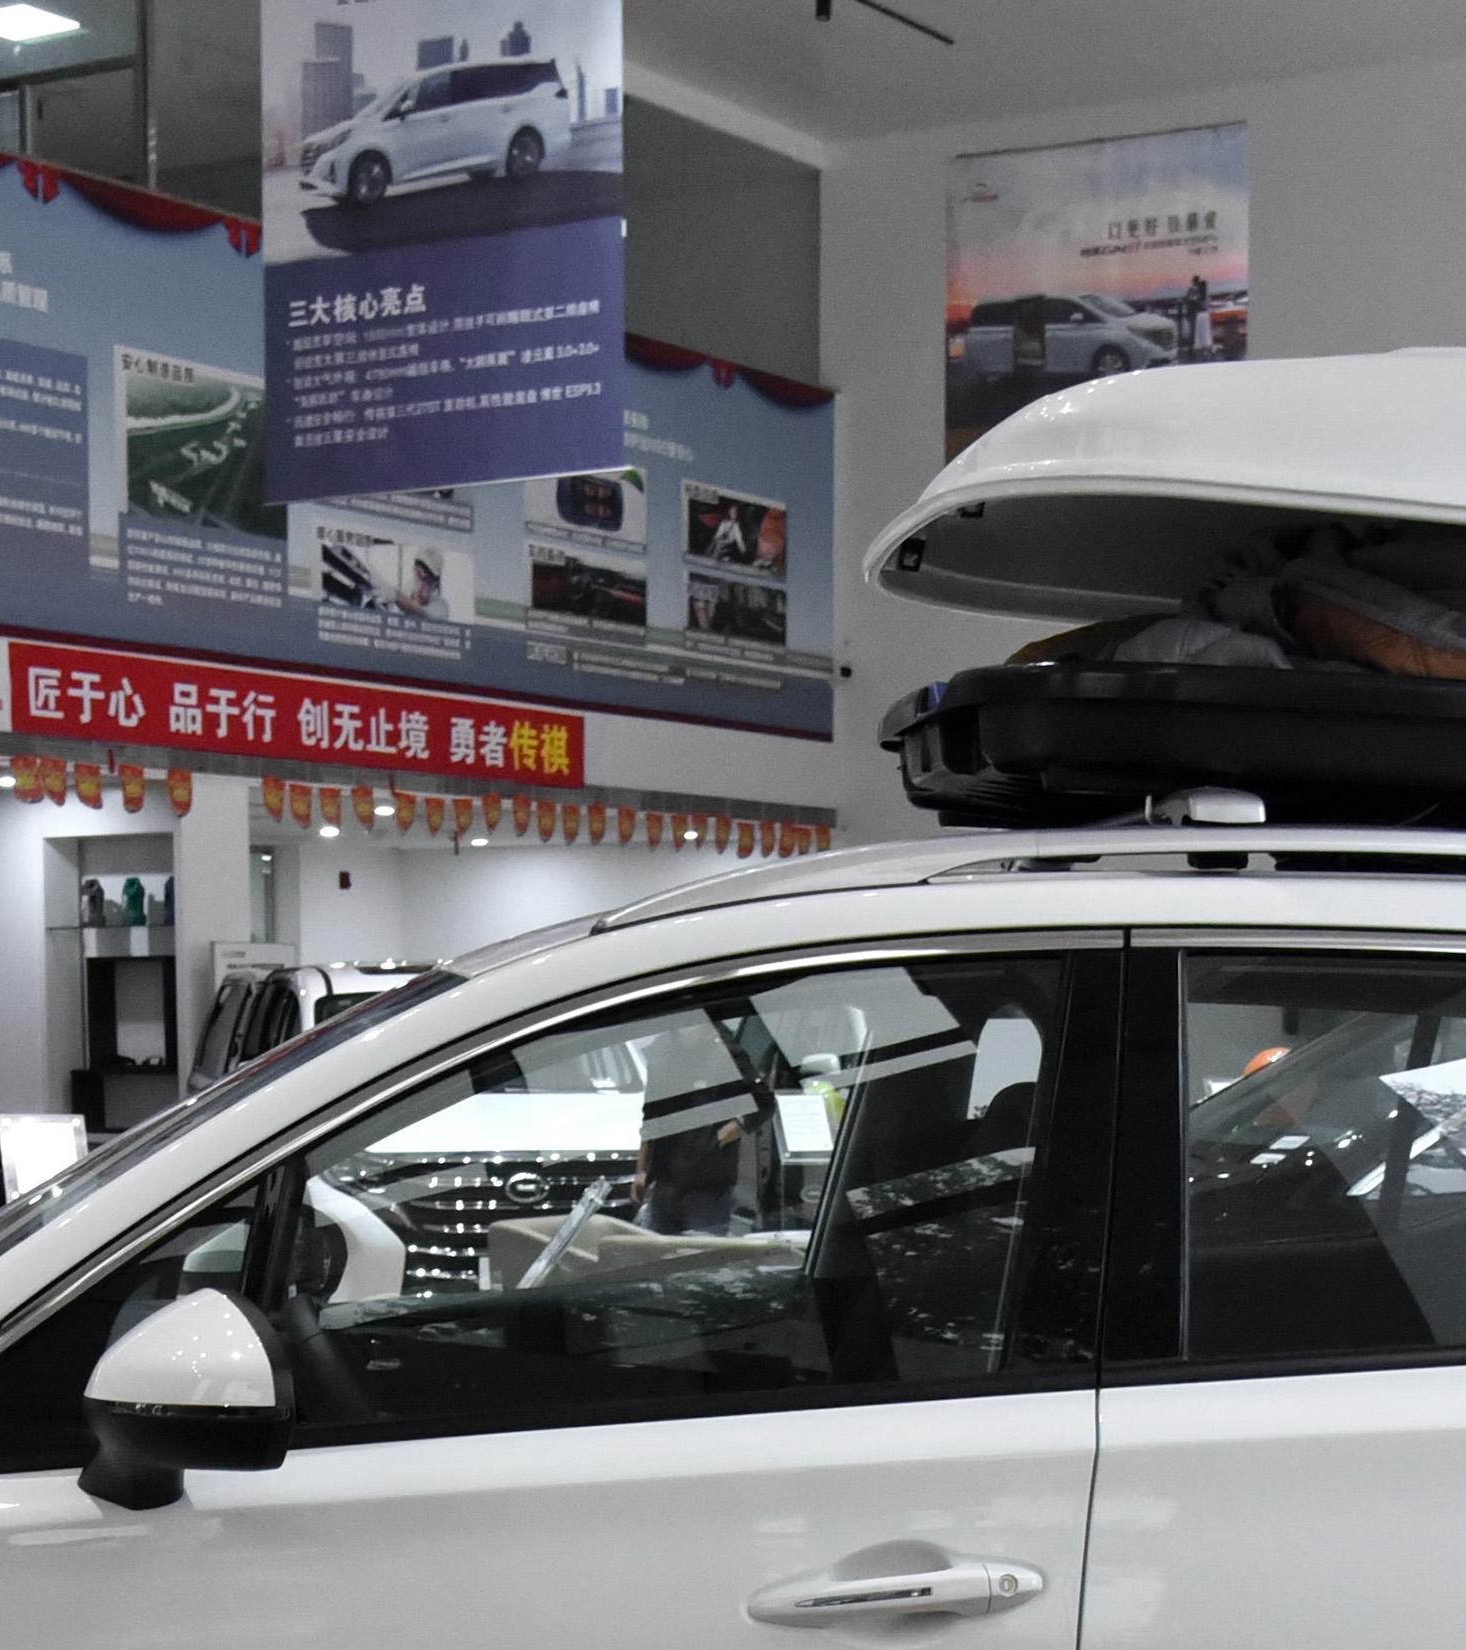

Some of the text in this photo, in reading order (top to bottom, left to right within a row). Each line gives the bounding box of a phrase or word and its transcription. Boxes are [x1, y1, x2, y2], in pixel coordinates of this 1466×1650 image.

[288, 284, 427, 327] 三大核心亮点
[27, 667, 571, 774] 匠于心 品于行 创无止境 勇者传祺
